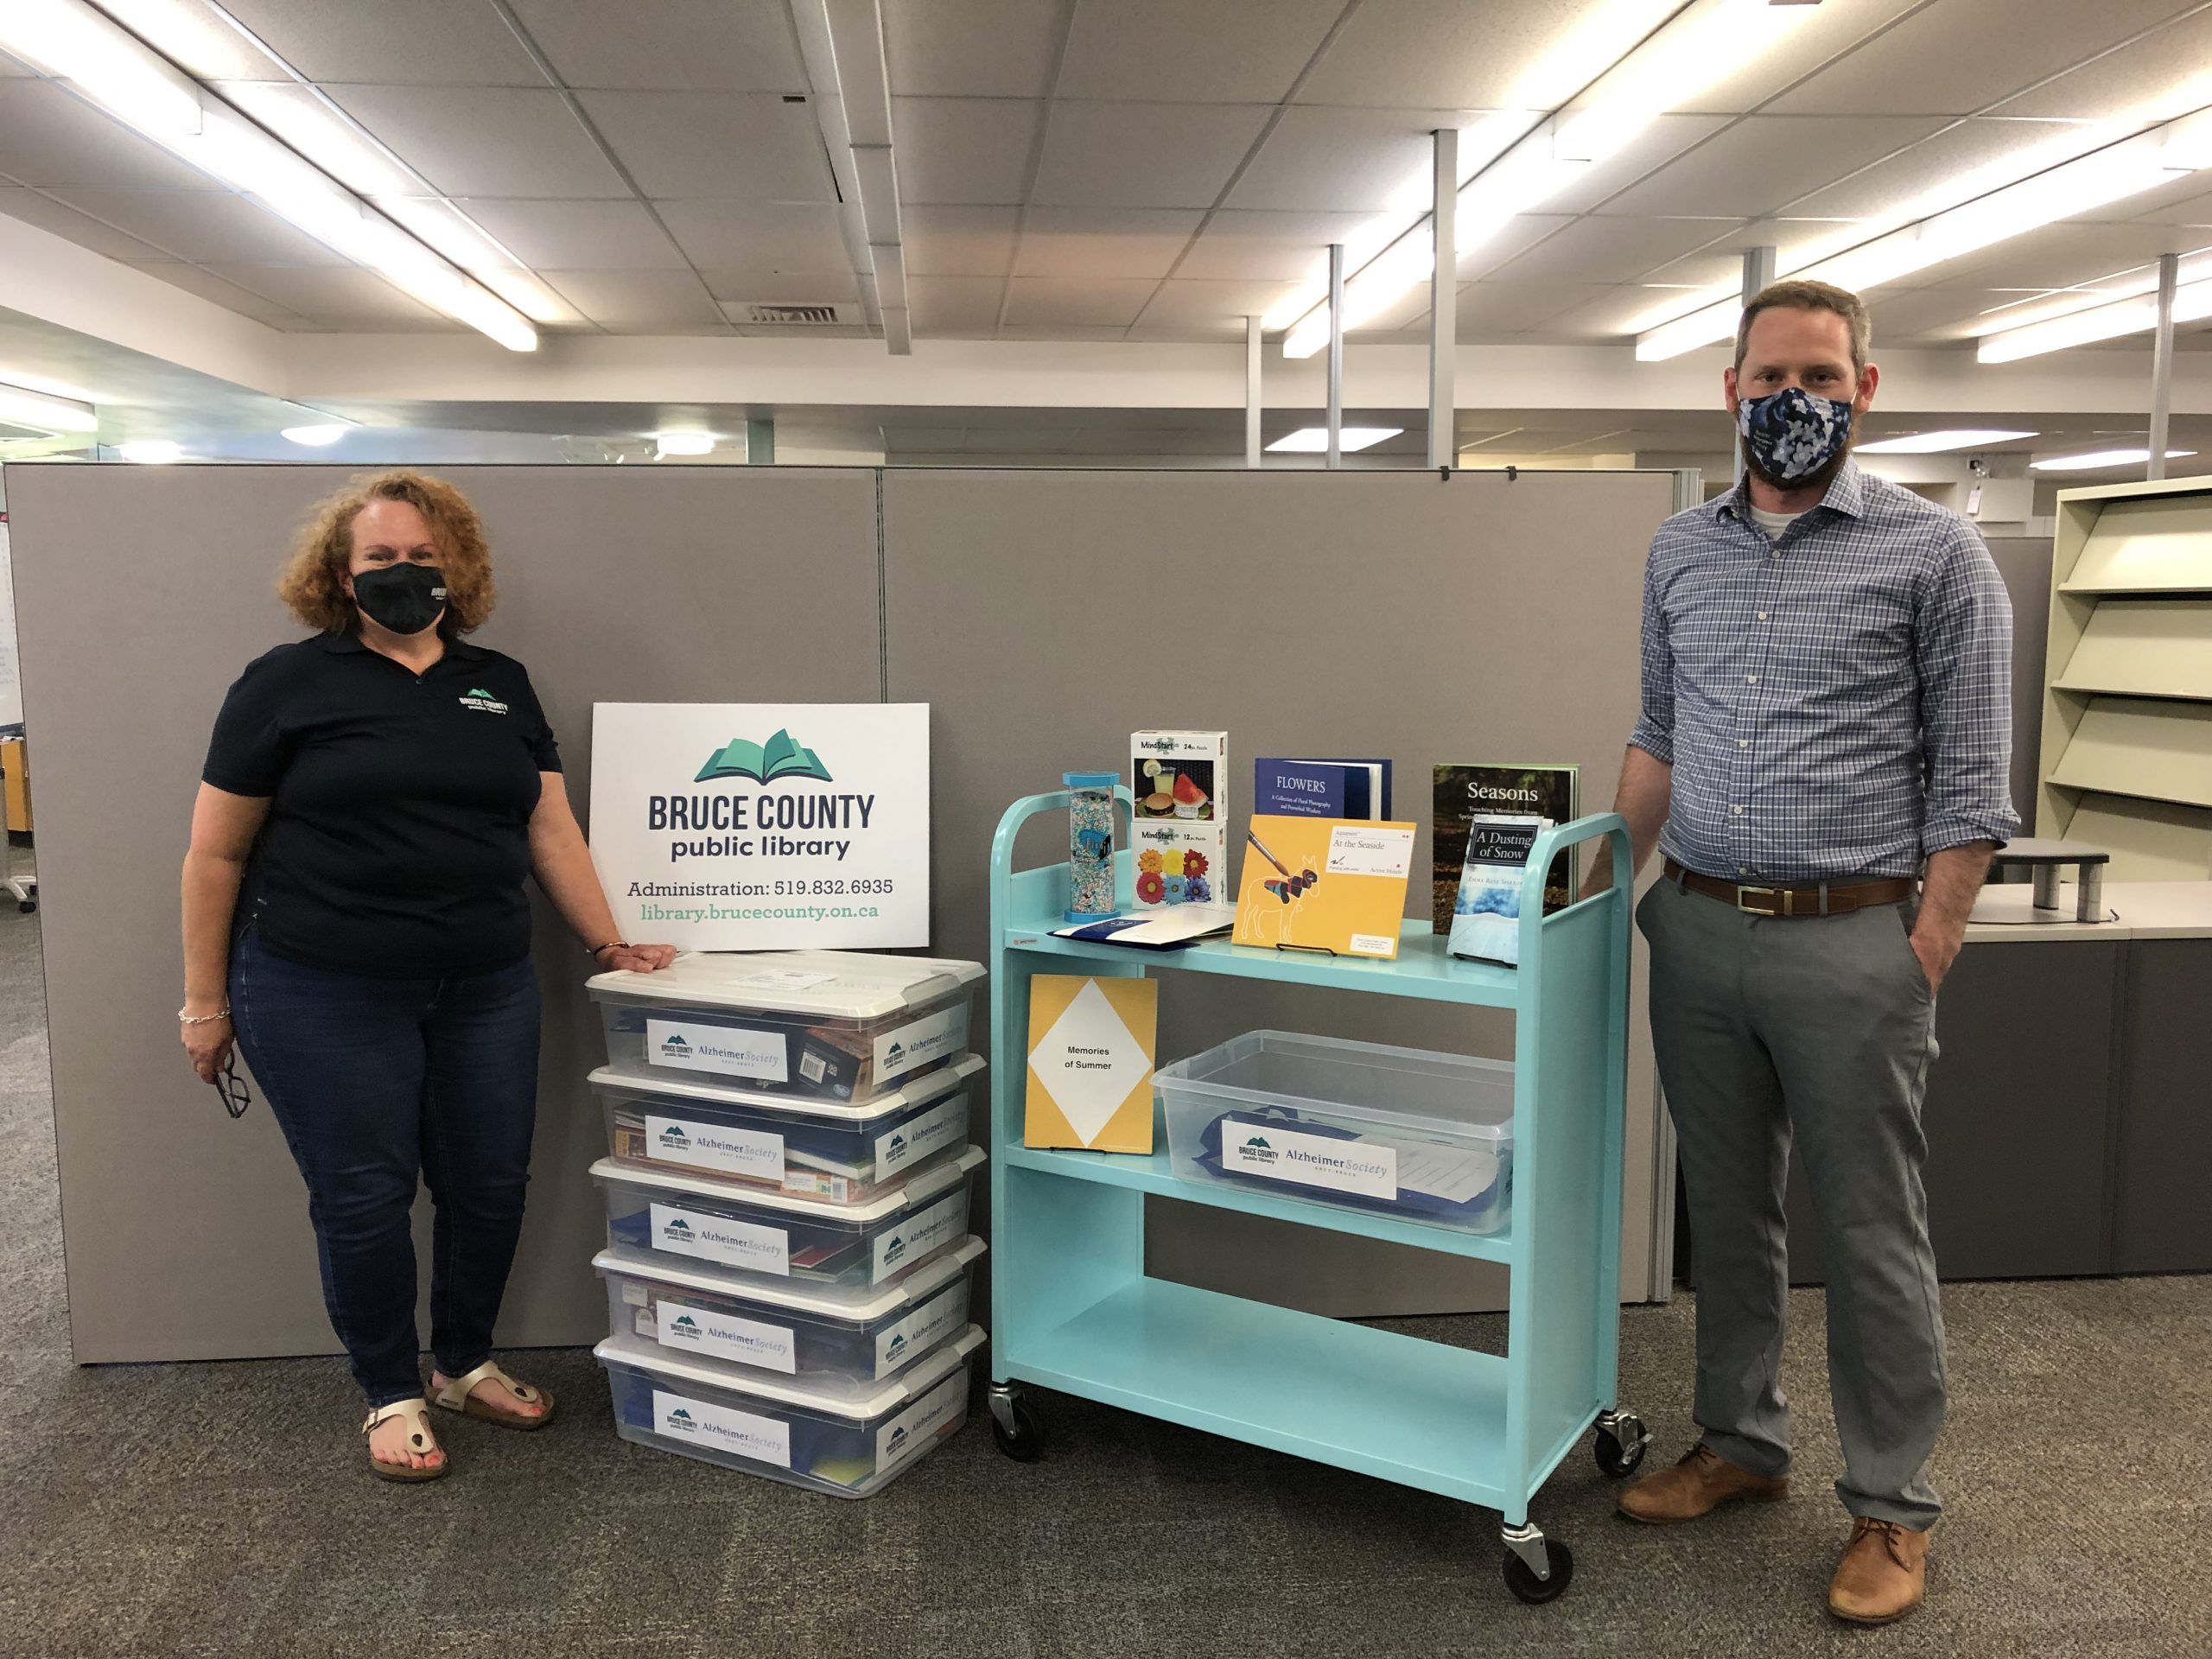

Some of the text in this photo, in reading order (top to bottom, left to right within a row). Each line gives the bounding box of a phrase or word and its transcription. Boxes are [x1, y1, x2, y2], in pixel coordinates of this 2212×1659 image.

[459, 697, 508, 711] BRUCE COUNTY
[1141, 741, 1173, 750] MindStart
[1276, 776, 1325, 793] FLOWERS
[1467, 782, 1539, 802] Seasons
[648, 794, 874, 830] BRUCE COUNTY
[1469, 806, 1495, 815] Touching
[1141, 831, 1173, 841] MindStart
[1333, 839, 1385, 850] At the Seaside
[1476, 831, 1532, 849] A Dusting
[671, 836, 850, 862] public library
[1479, 845, 1524, 859] of Snow
[626, 879, 893, 897] Administration: 519.832.6935
[640, 904, 879, 924] library.brucecounty.on.ca
[676, 1046, 693, 1054] COUNTY
[909, 1033, 942, 1054] Alzheimer
[1067, 1046, 1109, 1056] Memories
[698, 1046, 779, 1067] Alzheimer Society
[1076, 1060, 1112, 1070] Summer
[659, 1135, 691, 1147] BRUCE COUNTY
[911, 1121, 944, 1144] Alzheimer
[696, 1137, 778, 1162] Alzheimer Society
[1238, 1146, 1279, 1160] BRUCE COUNTY
[1258, 1157, 1275, 1166] library
[1286, 1149, 1388, 1179] Alzheimer Society
[664, 1227, 696, 1240] BRUCE COUNTY
[909, 1219, 942, 1244] Alzheimer
[700, 1230, 747, 1248] Alzheimer
[747, 1239, 781, 1258] Society
[671, 1323, 702, 1337] BRUCE COUNTY
[912, 1315, 943, 1343] Alzheimer
[707, 1328, 754, 1345] Alzheimer
[754, 1337, 788, 1356] Society
[912, 1406, 943, 1433] Alzheimer
[702, 1422, 748, 1441] Alzheimer
